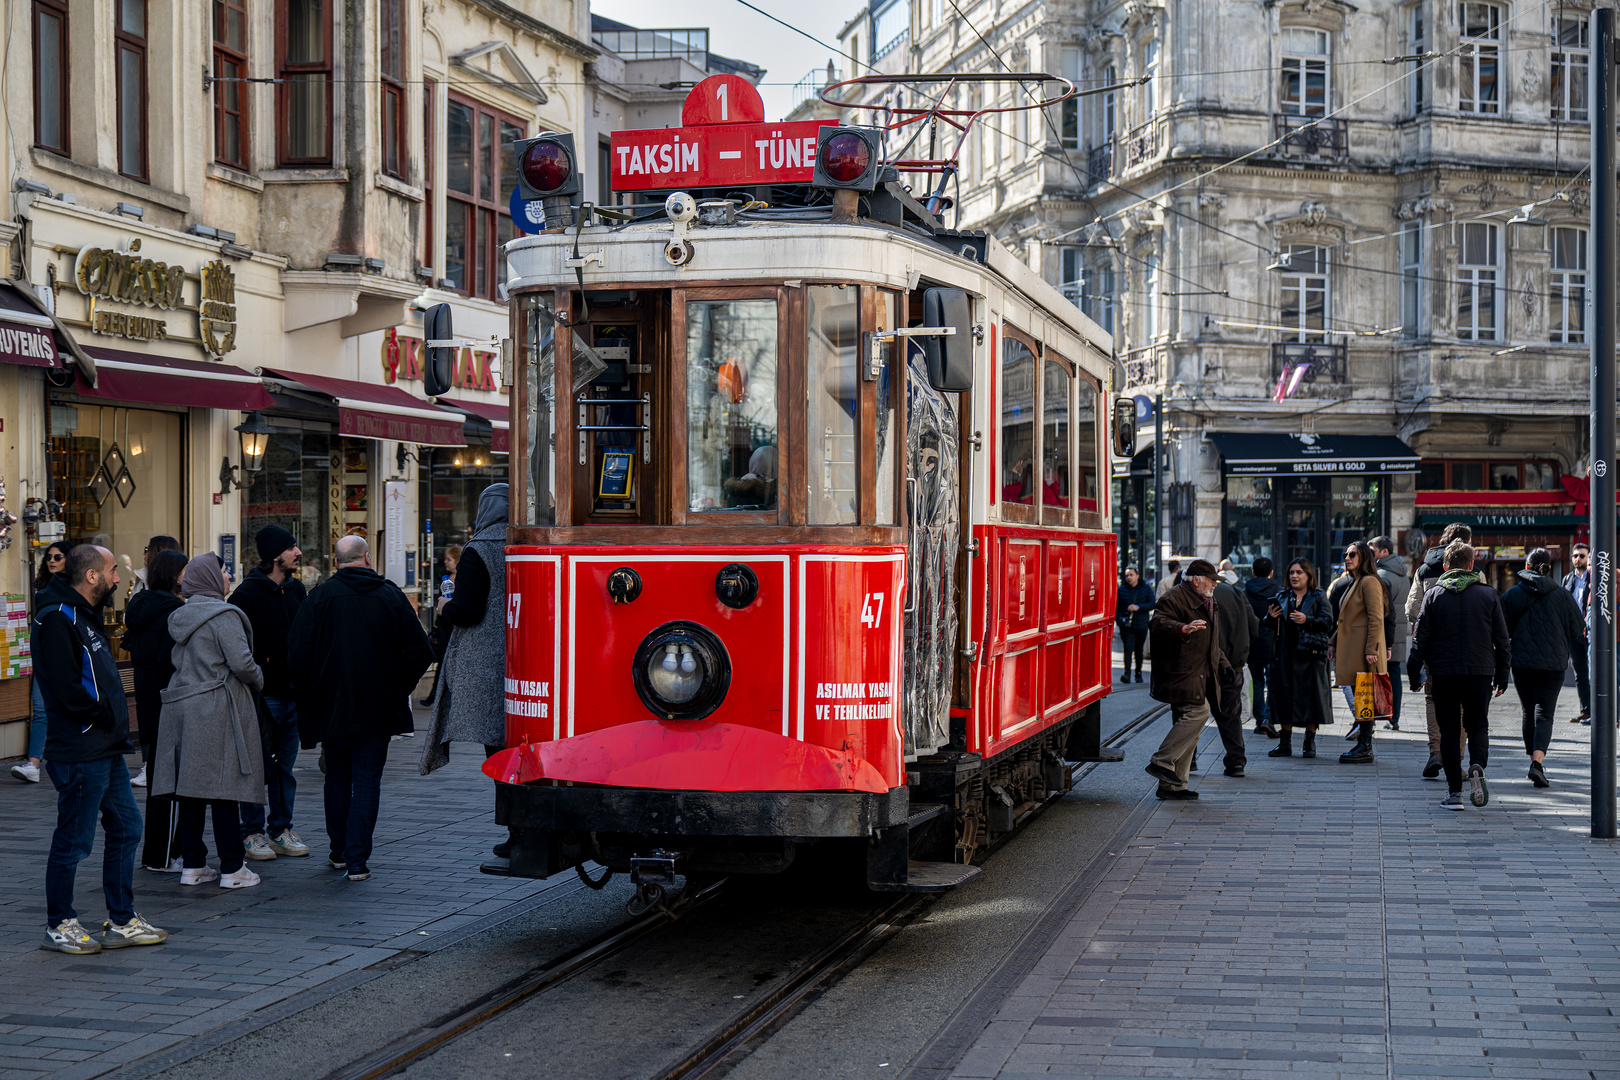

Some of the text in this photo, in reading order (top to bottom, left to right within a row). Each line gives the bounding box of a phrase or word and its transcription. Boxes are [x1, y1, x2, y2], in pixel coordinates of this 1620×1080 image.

[716, 83, 728, 121] 1
[616, 134, 699, 176] TAKSİM
[755, 131, 816, 169] TÜNE
[97, 309, 167, 341] PERFUMES
[399, 336, 497, 391] KAK
[1293, 462, 1365, 472] SETA SILVER & GOLD
[331, 475, 340, 538] KONAK
[1477, 515, 1536, 525] VITAVIEN
[507, 593, 521, 629] 47
[860, 592, 884, 629] 47
[520, 680, 549, 697] YASAK
[816, 682, 866, 699] ASILMAK
[815, 701, 892, 720] VE TEHLİKELİDİR
